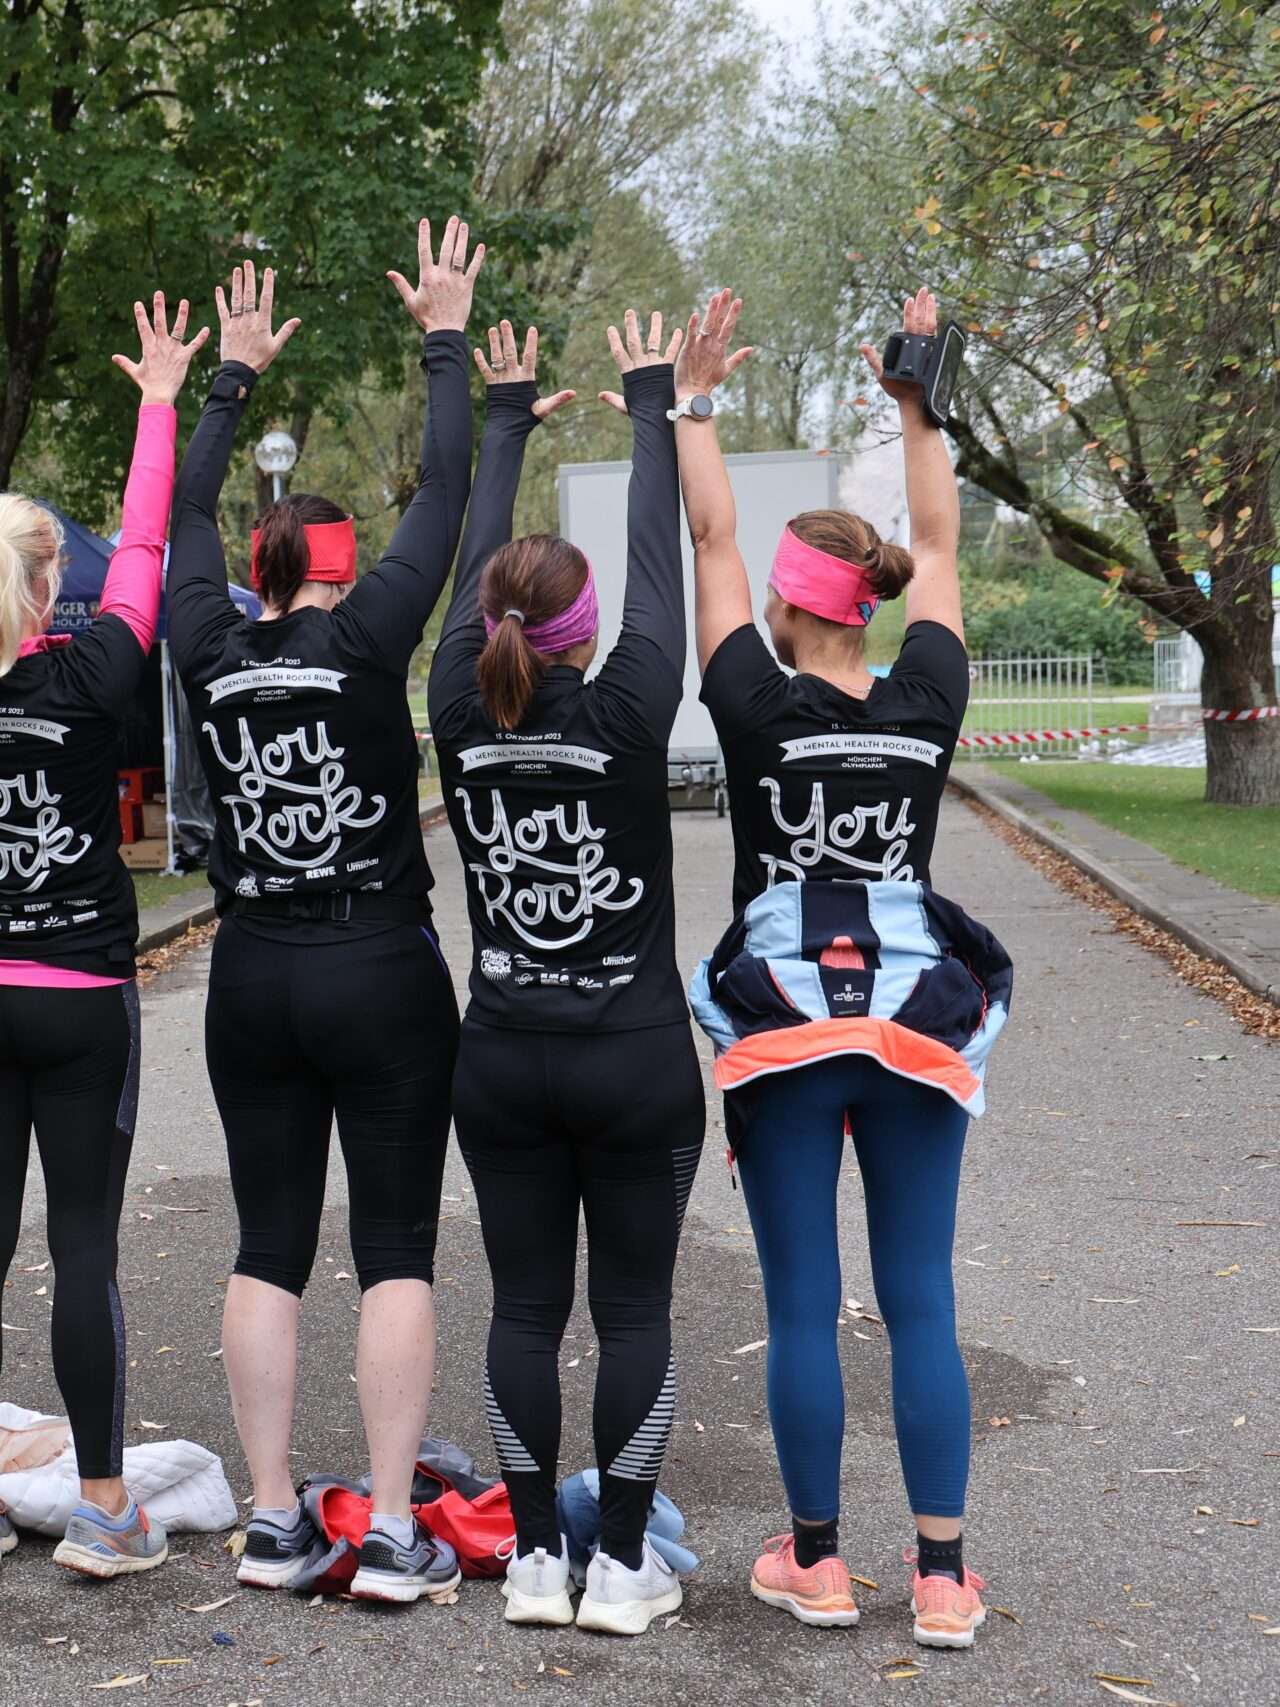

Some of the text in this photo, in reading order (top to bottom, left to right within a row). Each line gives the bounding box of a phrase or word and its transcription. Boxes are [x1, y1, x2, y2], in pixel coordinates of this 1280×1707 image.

[221, 678, 251, 690] MENTAL
[252, 673, 284, 683] HEALTH
[314, 674, 332, 683] RUN
[257, 688, 287, 696] MÜNCHEN
[8, 707, 25, 715] 2023
[11, 721, 37, 730] ROCKS
[39, 725, 57, 735] RUN
[505, 732, 543, 741] OKTOBER
[475, 750, 508, 761] MENTAL
[510, 749, 543, 757] HEALTH
[546, 750, 576, 760] ROCKS
[578, 753, 597, 764] RUN
[803, 741, 841, 751] MENTAL
[844, 740, 880, 749] HEALTH
[882, 741, 912, 752] ROCKS
[914, 747, 933, 757] RUN
[202, 716, 345, 799] You
[515, 762, 548, 770] MÜNCHEN
[220, 761, 387, 869] Rock
[758, 776, 917, 866] You
[455, 786, 606, 873] You
[305, 865, 337, 880] REWE
[469, 842, 645, 950] Rock
